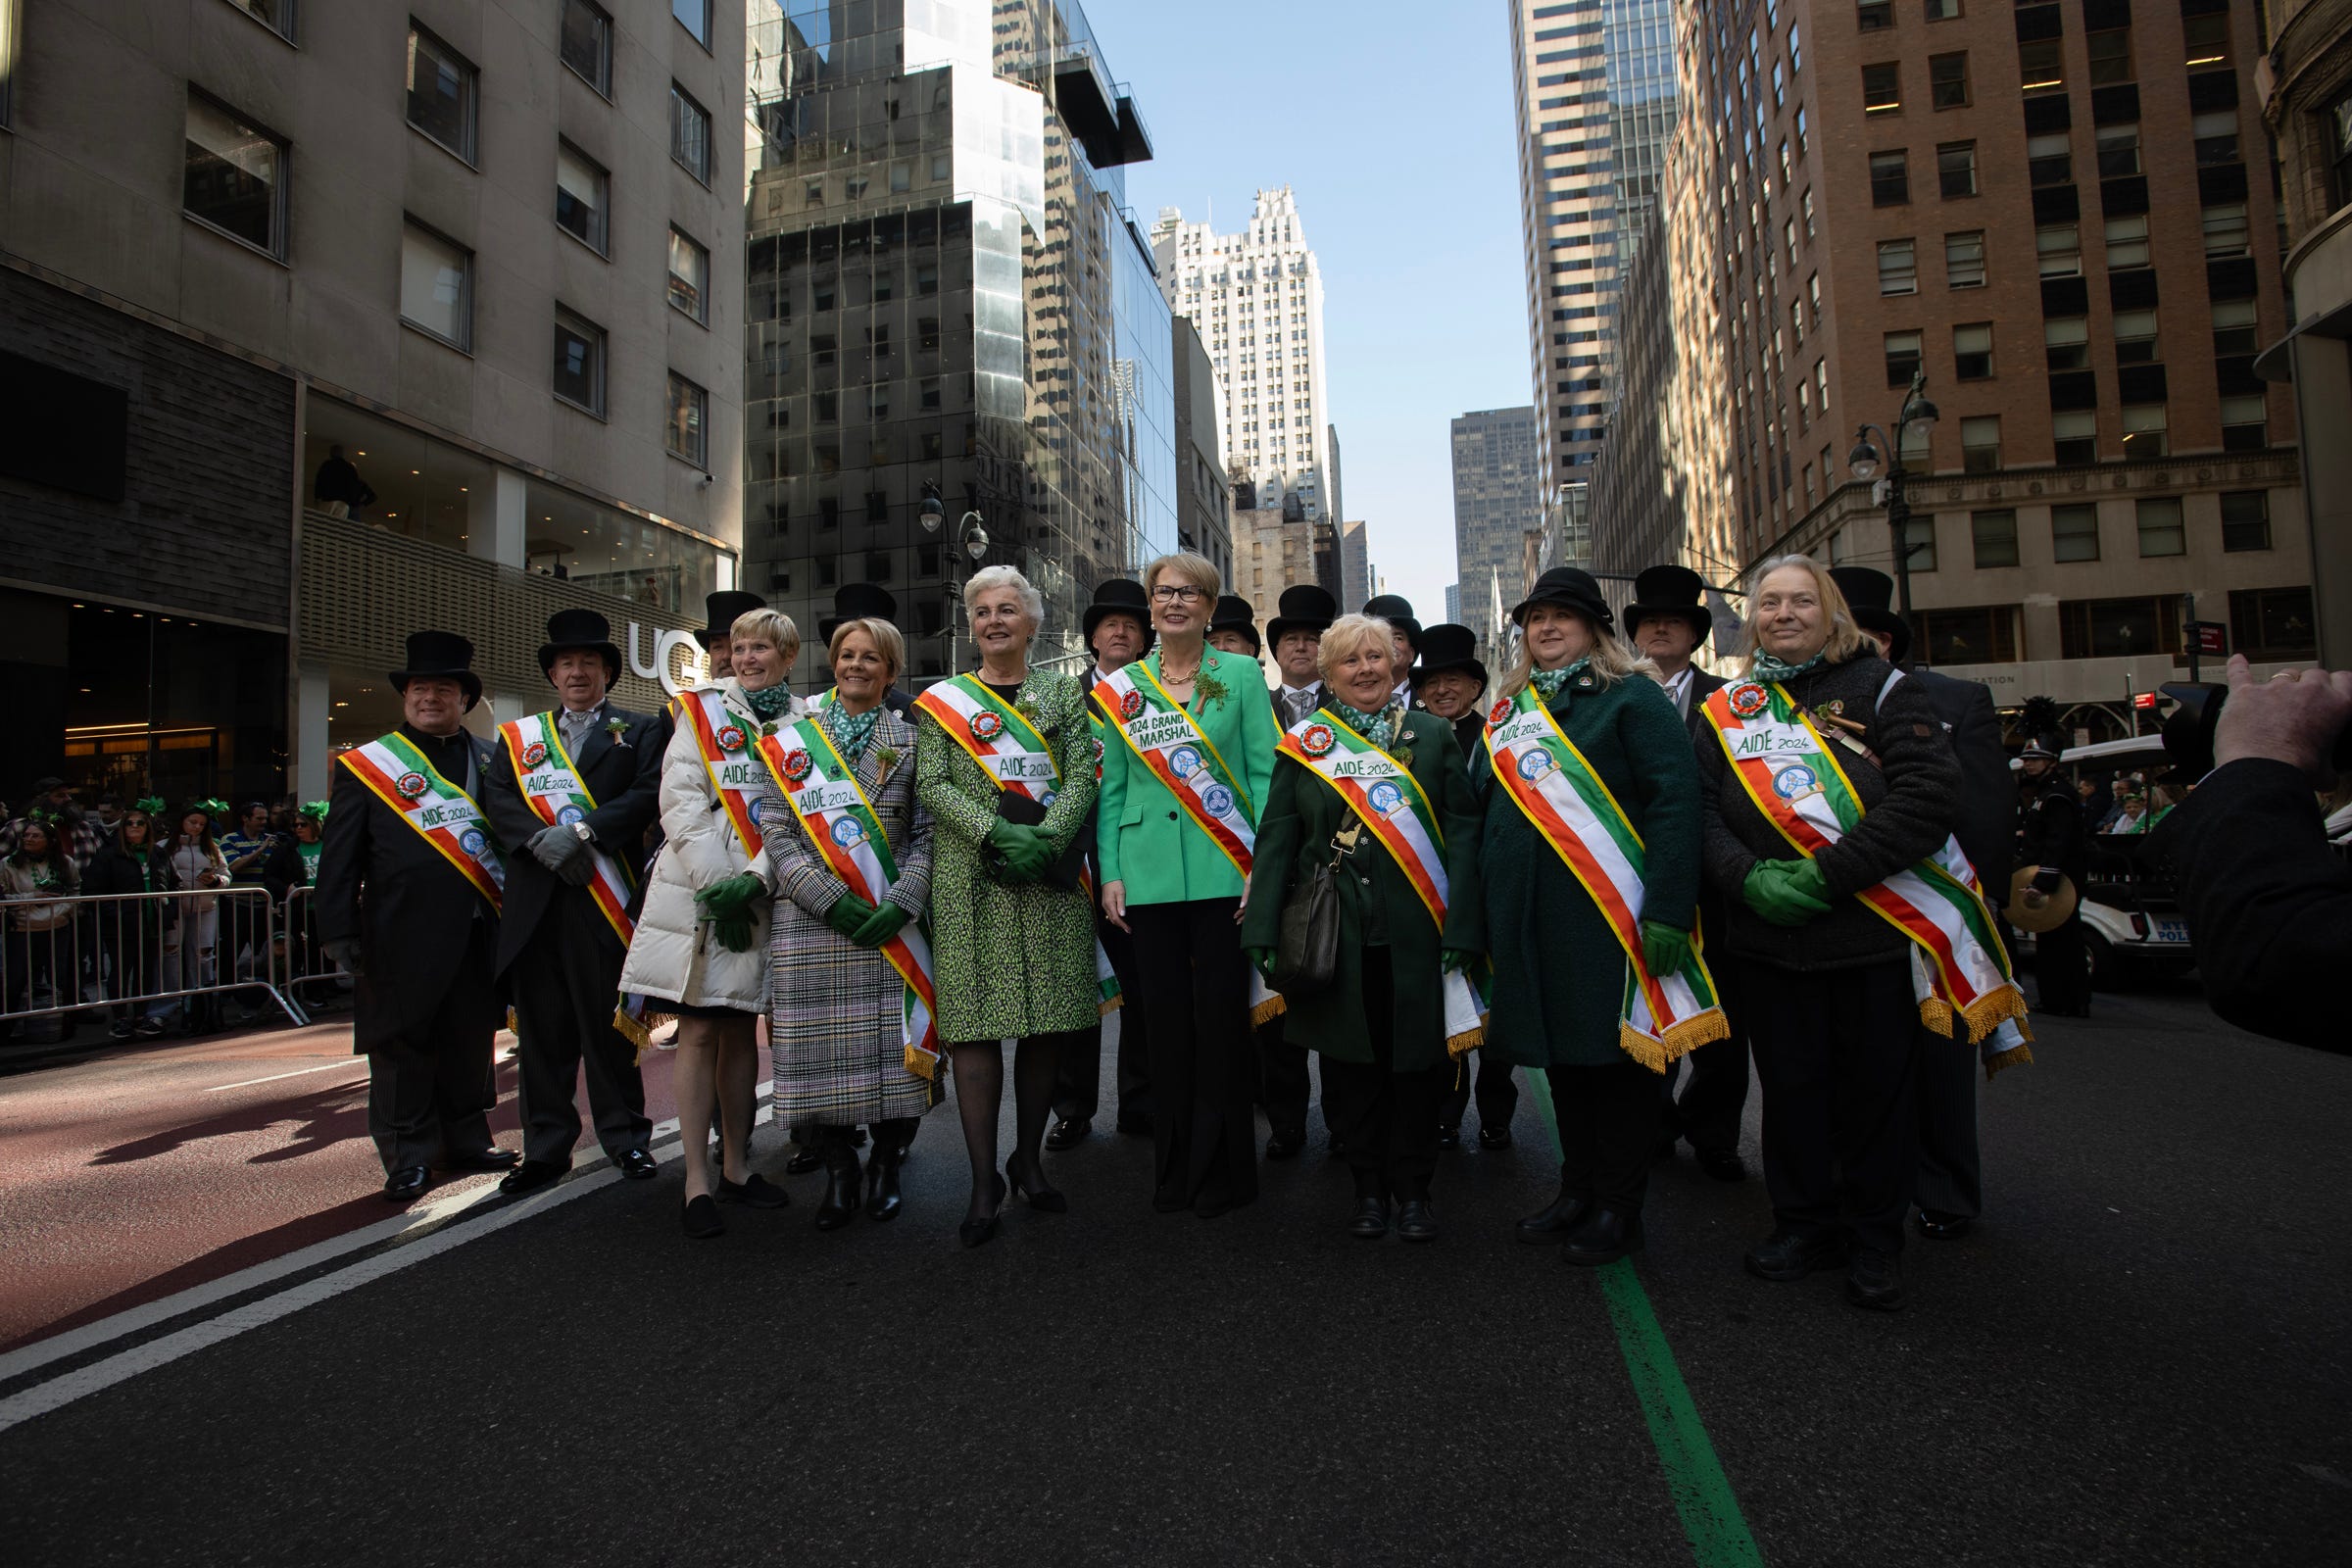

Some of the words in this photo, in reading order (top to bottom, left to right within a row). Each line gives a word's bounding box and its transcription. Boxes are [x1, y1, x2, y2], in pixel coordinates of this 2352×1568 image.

[1128, 718, 1149, 737] 2024
[1152, 713, 1184, 729] GRAND
[1139, 724, 1194, 748] MARSHAL
[1496, 718, 1521, 748] AIDE
[1521, 721, 1543, 736] 2024
[1737, 729, 1772, 754] AIDE
[1778, 737, 1809, 750] 2024
[722, 764, 750, 784] AIDE
[1000, 758, 1026, 777] AIDE
[1334, 760, 1365, 776] AIDE
[1367, 762, 1396, 775] 2024
[527, 774, 552, 794] AIDE
[552, 779, 573, 790] 2024
[800, 787, 826, 812] AIDE
[828, 791, 857, 806] 2024
[421, 806, 448, 829] AIDE
[448, 807, 473, 821] 2024
